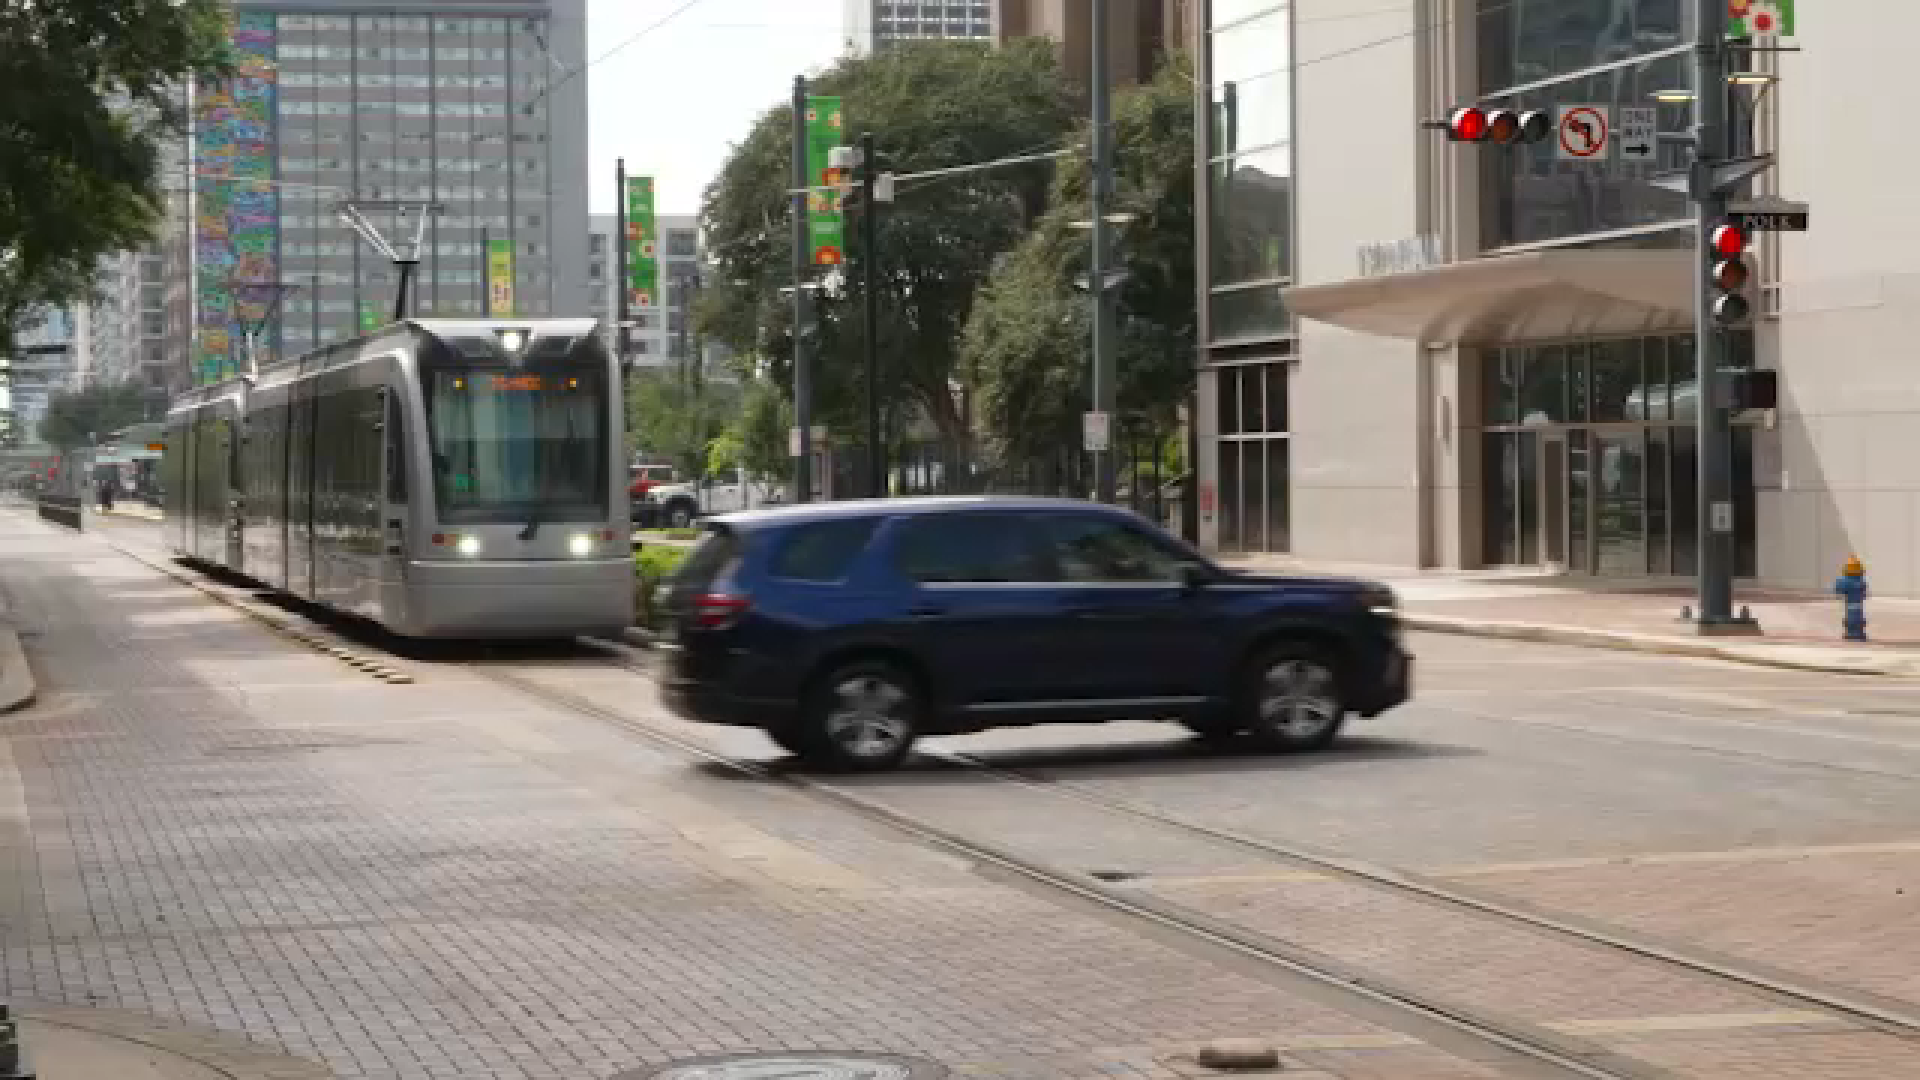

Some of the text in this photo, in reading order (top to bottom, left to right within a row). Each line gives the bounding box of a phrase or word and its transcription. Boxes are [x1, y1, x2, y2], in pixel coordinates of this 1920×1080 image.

[1623, 110, 1653, 124] ONE
[1623, 126, 1653, 139] WAY
[1743, 215, 1791, 229] POLK
